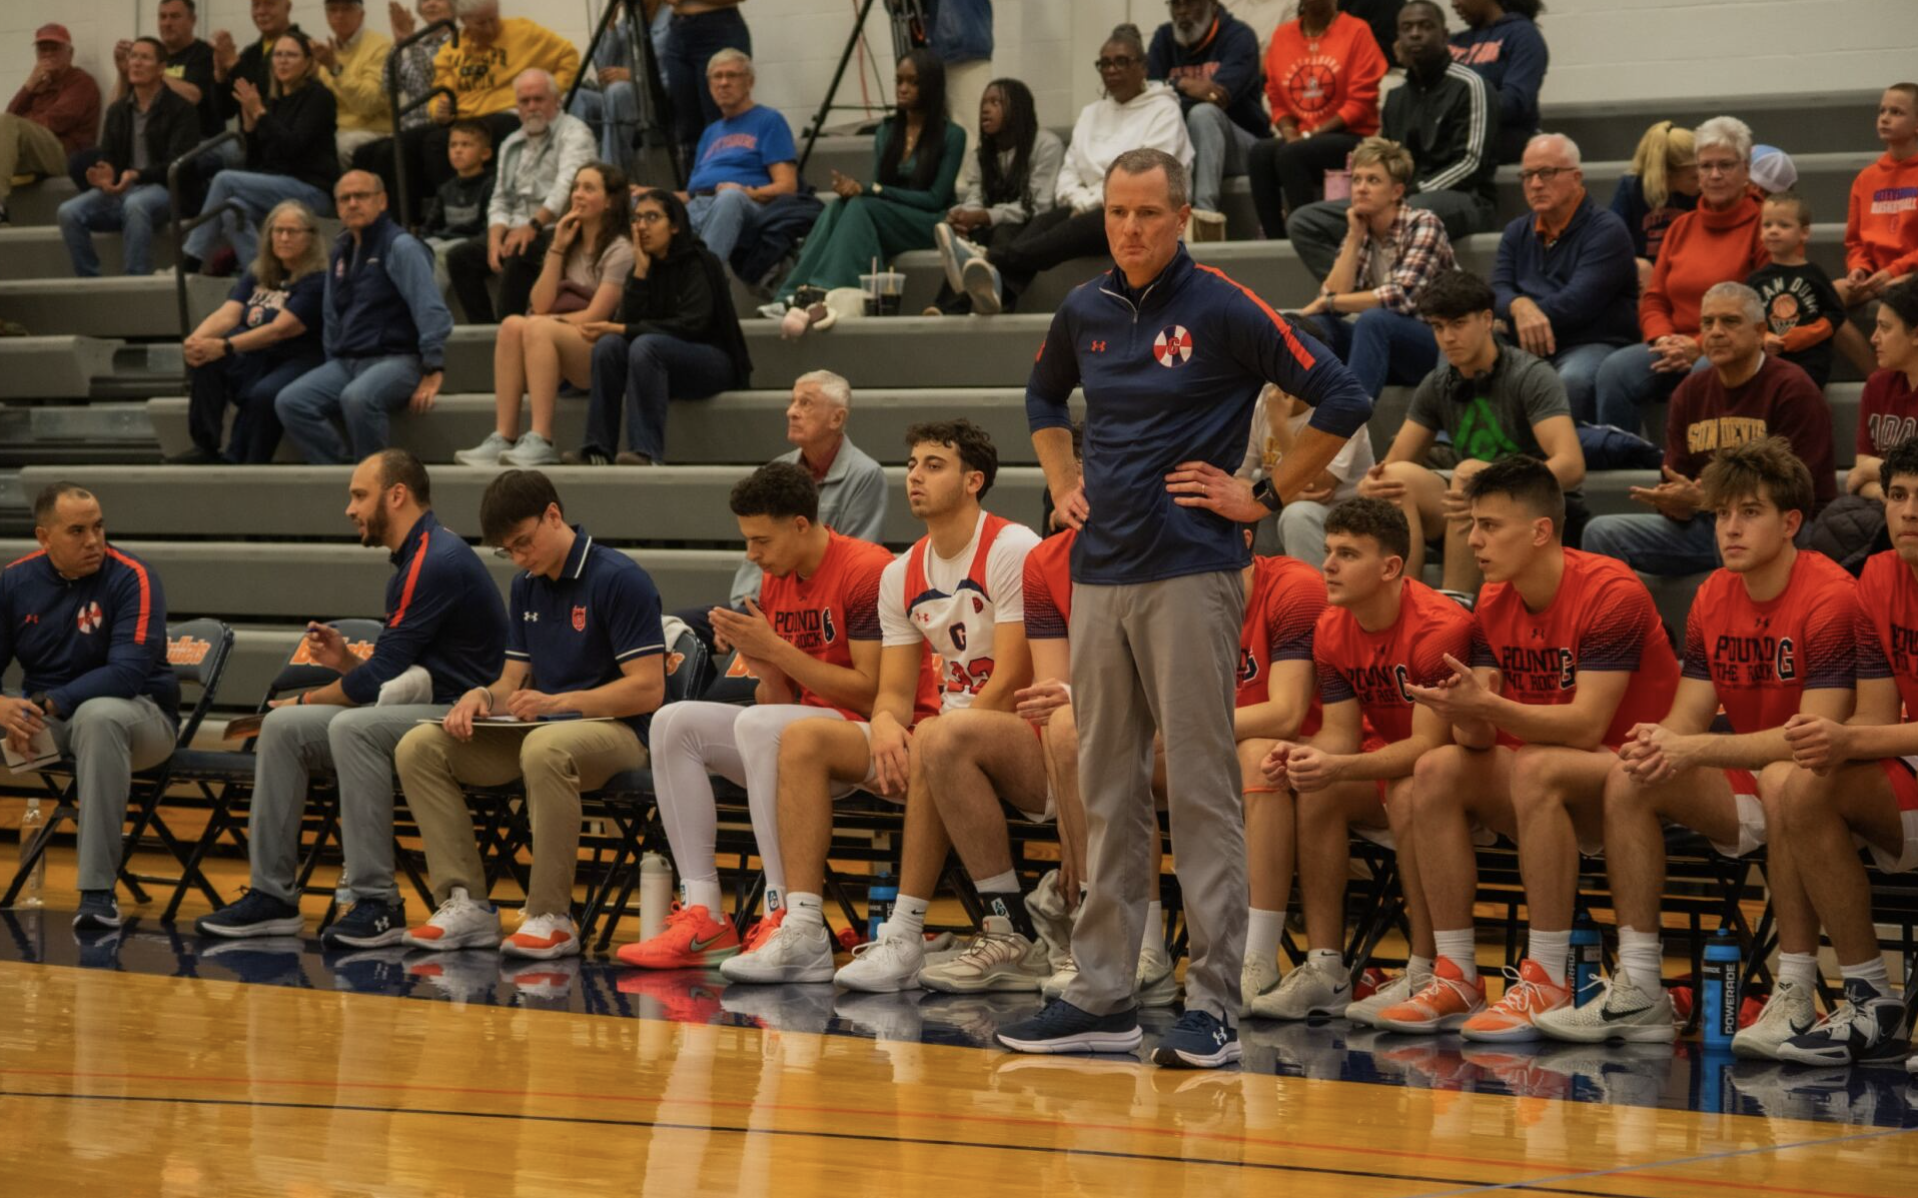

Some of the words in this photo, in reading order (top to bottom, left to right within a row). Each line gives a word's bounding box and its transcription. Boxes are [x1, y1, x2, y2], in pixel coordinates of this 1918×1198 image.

[167, 635, 211, 666] ullets
[1776, 636, 1797, 683] G
[1713, 661, 1738, 682] THE
[1724, 963, 1736, 1035] POWERADE
